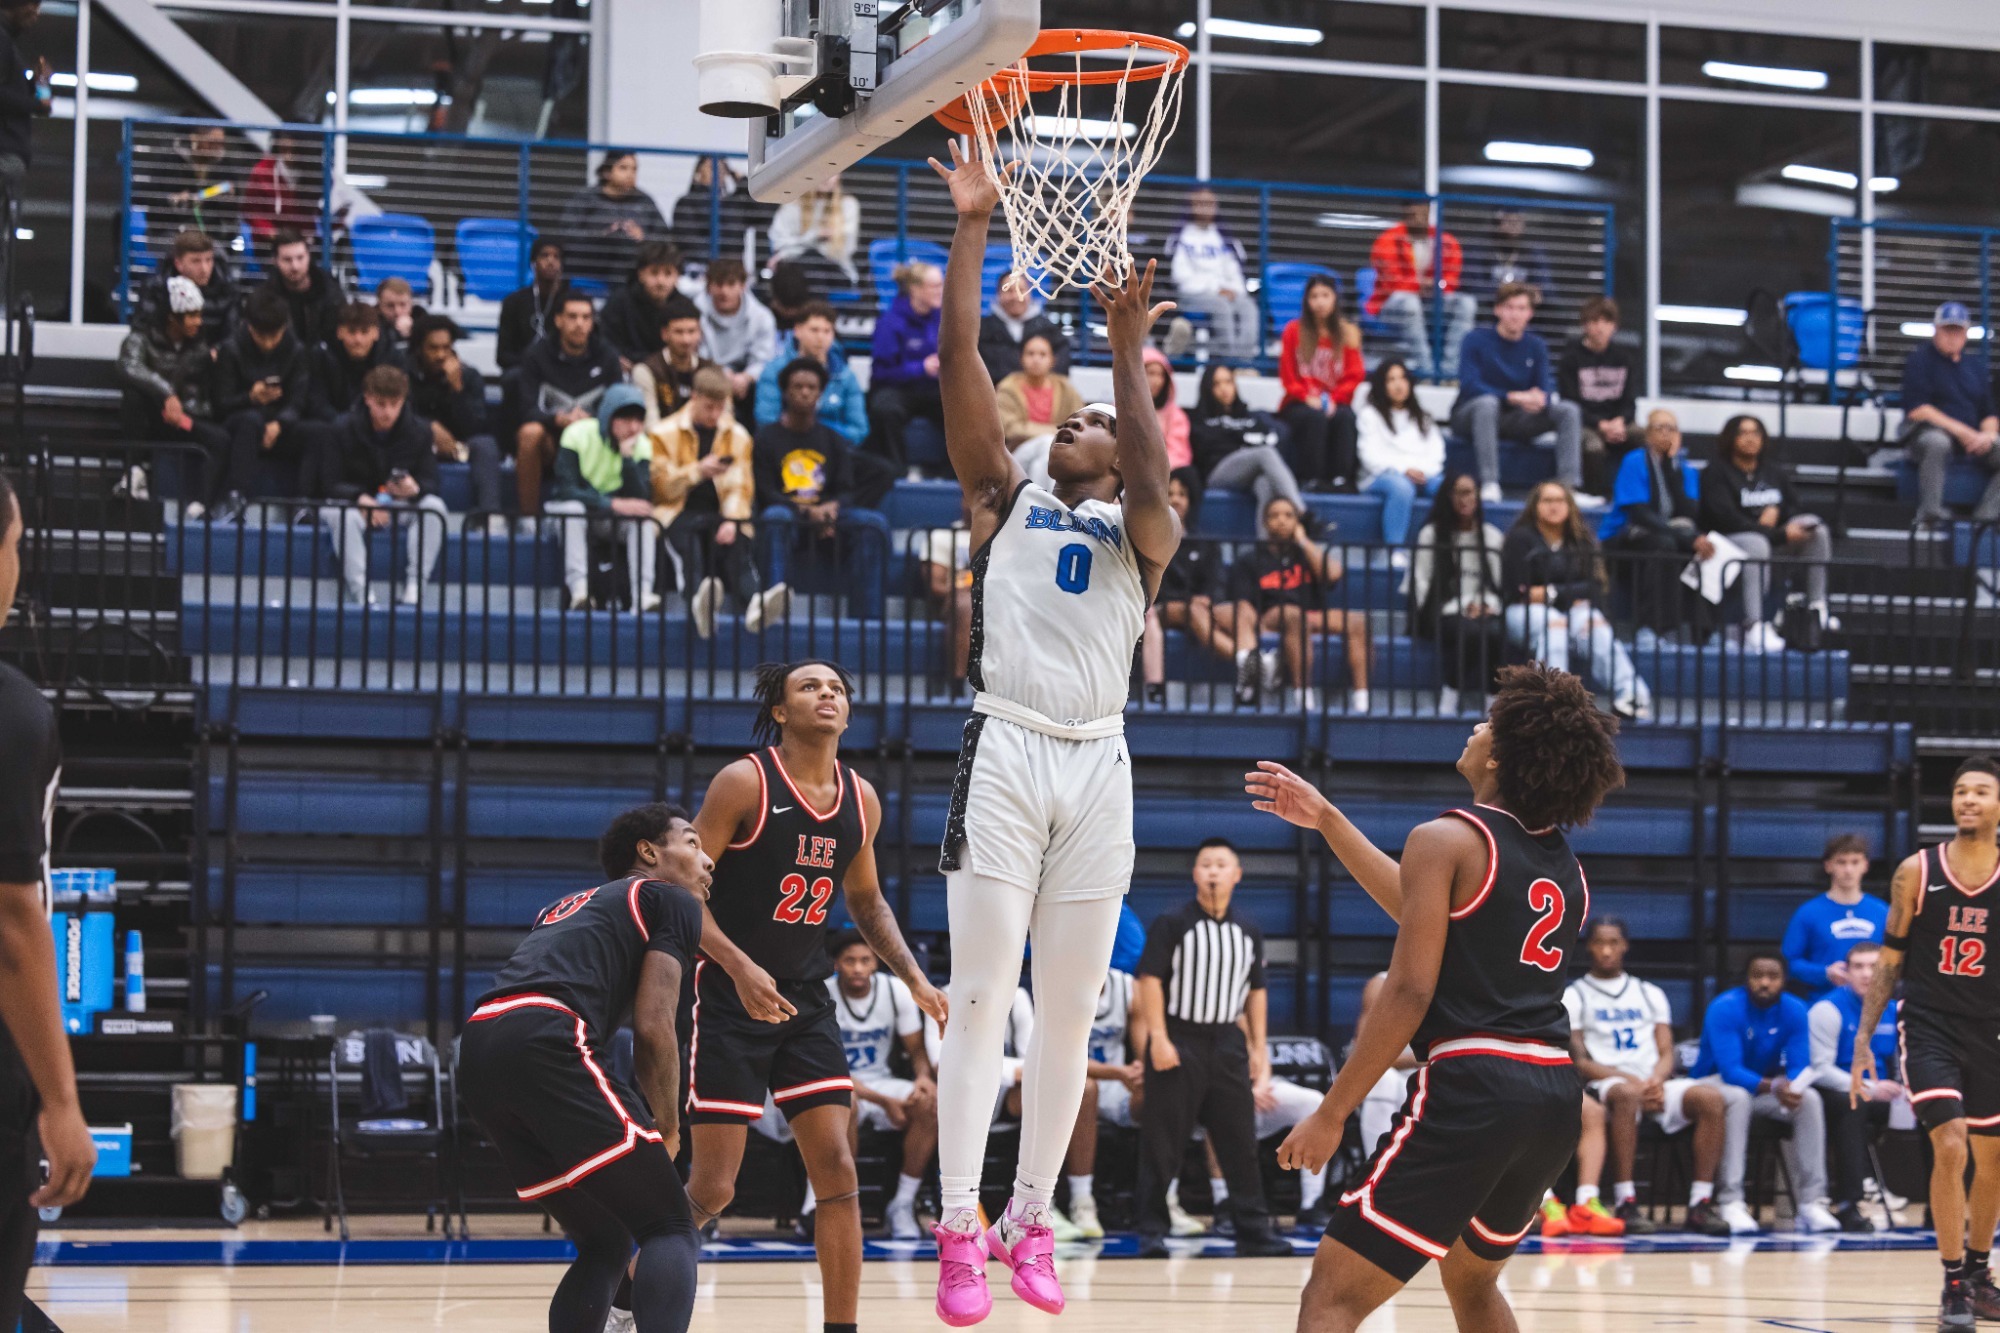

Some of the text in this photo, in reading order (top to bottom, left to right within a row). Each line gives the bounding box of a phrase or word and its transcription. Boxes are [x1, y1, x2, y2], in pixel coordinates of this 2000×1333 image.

[853, 77, 869, 87] 10'
[1025, 505, 1122, 553] BLINN
[1055, 543, 1093, 594] 0
[796, 834, 836, 869] LEE
[773, 873, 835, 925] 22
[1947, 905, 1989, 934] LEE
[1519, 878, 1566, 972] 2
[1938, 935, 1986, 977] 12
[1612, 1027, 1638, 1051] 12
